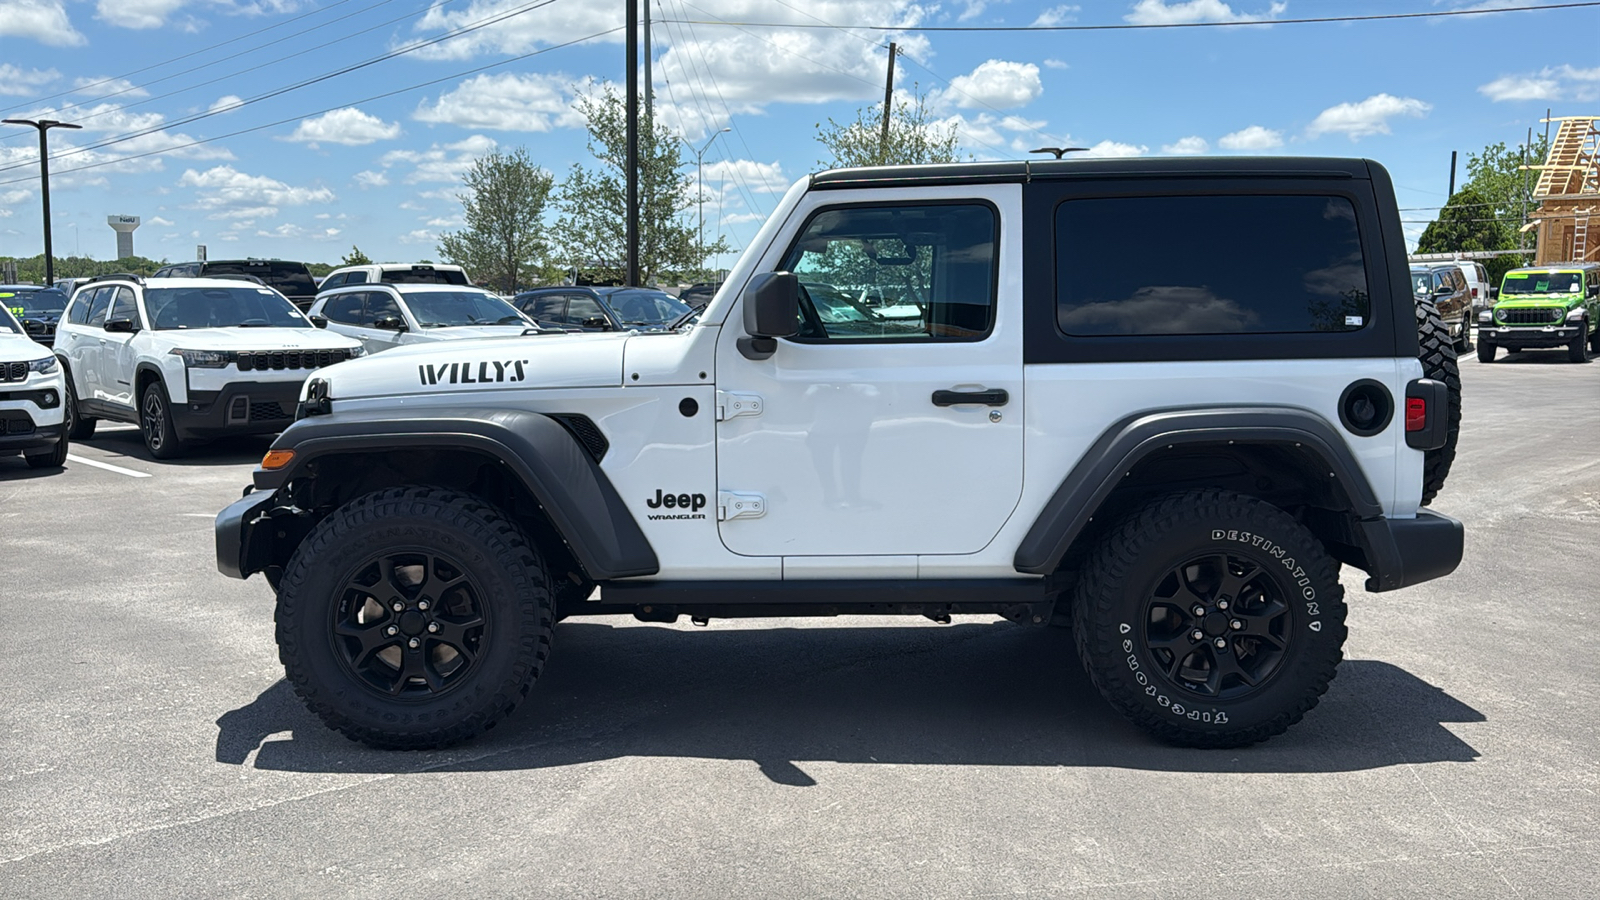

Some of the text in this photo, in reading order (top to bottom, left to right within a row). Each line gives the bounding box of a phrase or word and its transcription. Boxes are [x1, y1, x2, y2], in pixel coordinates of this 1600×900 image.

[418, 359, 529, 385] WILLYS
[646, 489, 706, 512] Jeep
[1212, 529, 1320, 616] DESTINATION
